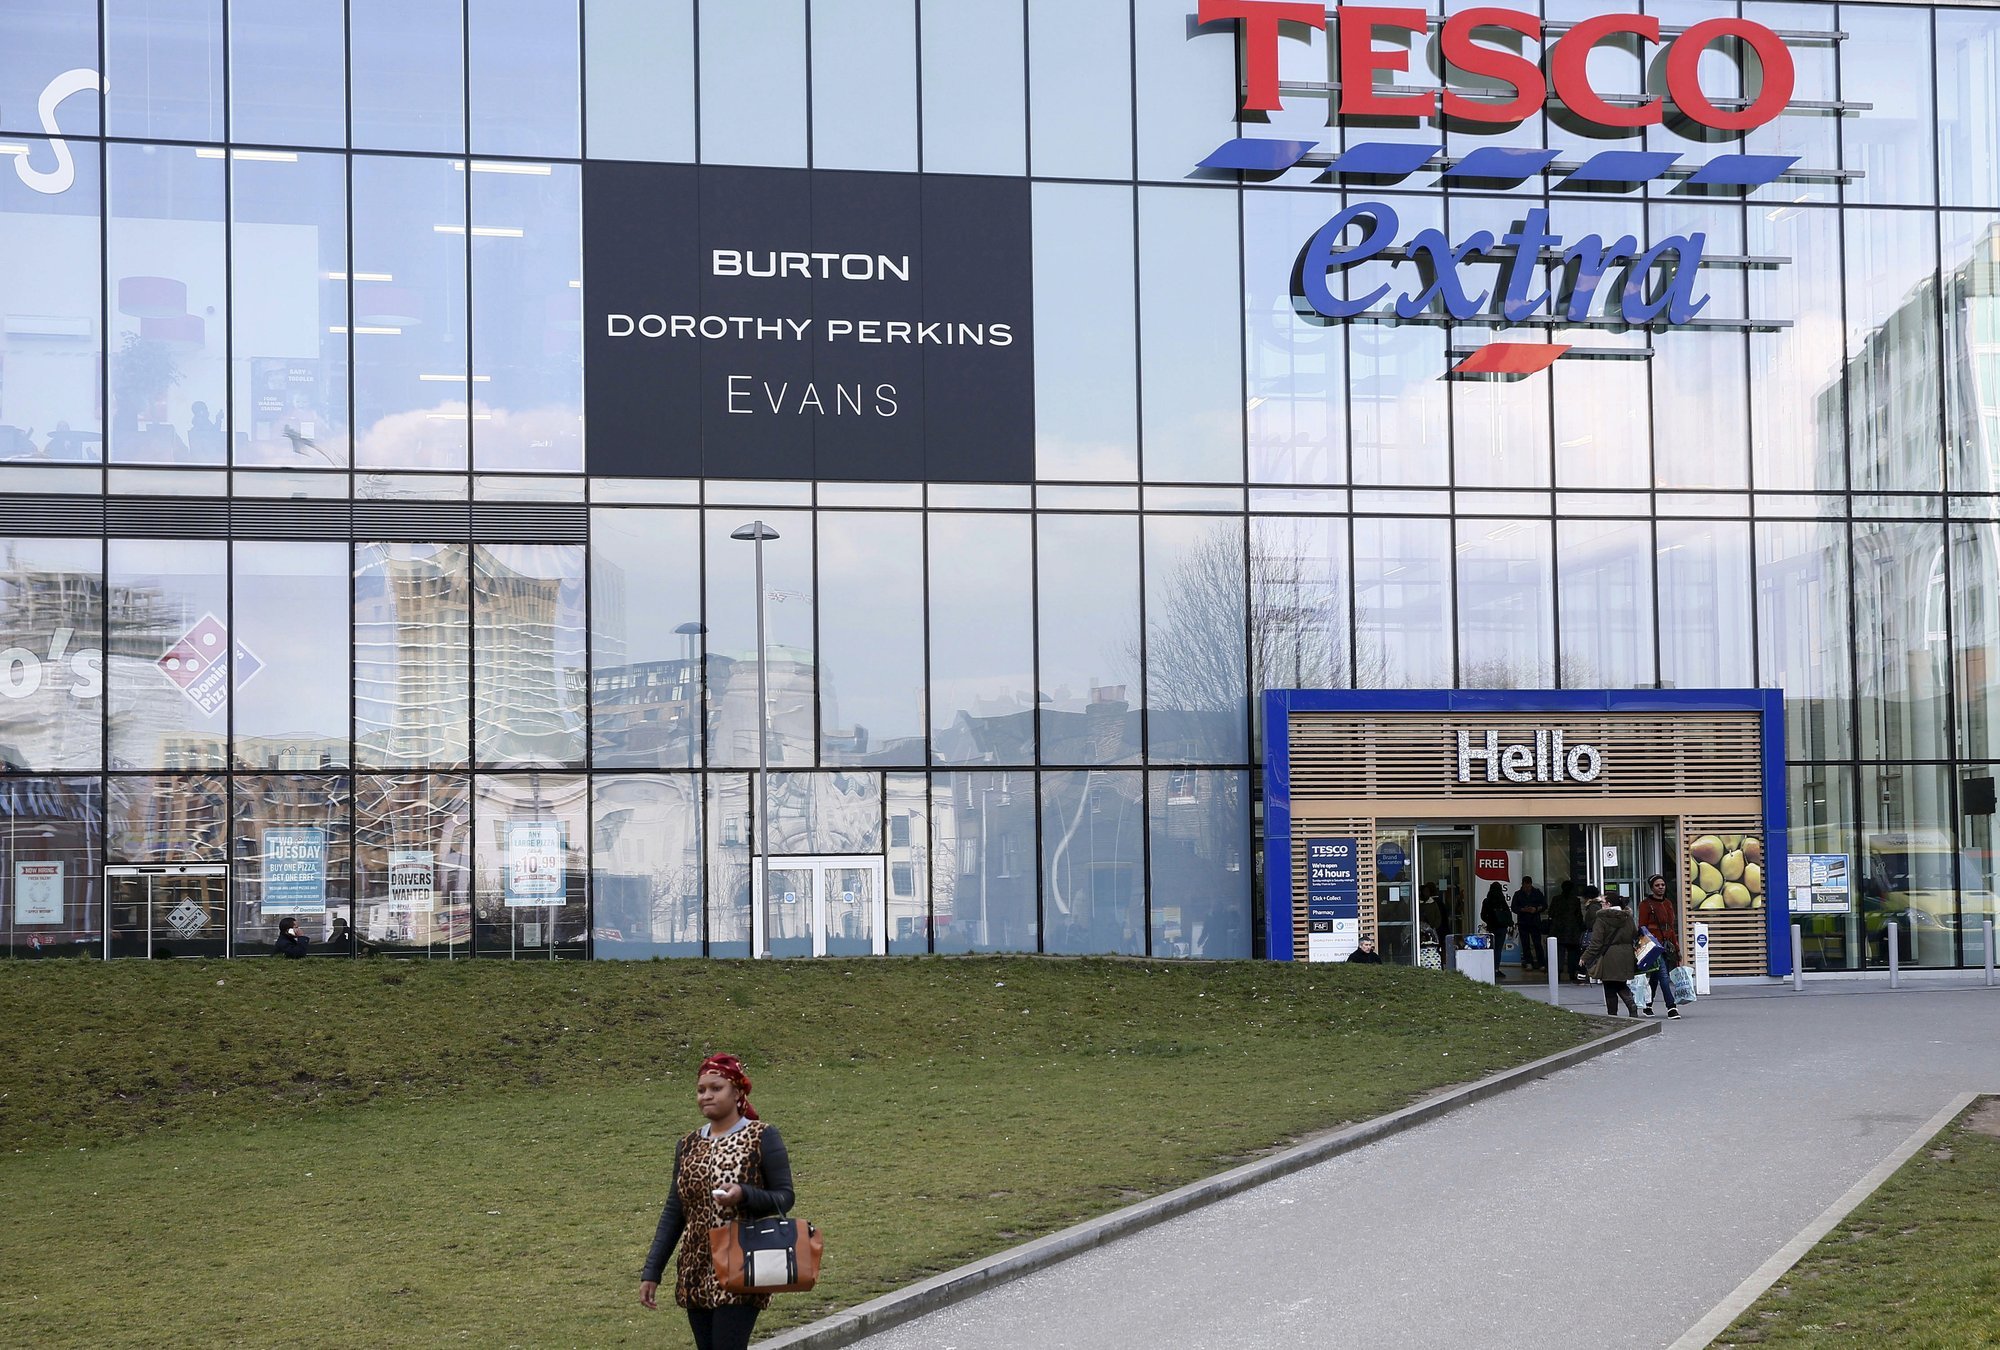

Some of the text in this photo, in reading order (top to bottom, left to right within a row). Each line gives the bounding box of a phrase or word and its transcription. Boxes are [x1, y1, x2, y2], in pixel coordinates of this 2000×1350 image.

[1198, 0, 1795, 130] TESCO
[712, 249, 909, 281] BURTON
[1301, 202, 1710, 325] extra
[607, 314, 1013, 346] DOROTHY PERKINS
[728, 375, 898, 417] EVANS
[1456, 729, 1602, 782] Hello
[266, 837, 321, 859] TUESDAY
[1312, 846, 1348, 854] TESCO
[270, 863, 282, 872] BUY
[283, 863, 296, 872] ONE
[514, 856, 556, 873] £10.99
[1479, 859, 1505, 868] FREE
[272, 873, 315, 881] GET ONE FREE
[391, 873, 432, 885] DRIVERS
[1312, 869, 1351, 878] 24 hours
[392, 888, 430, 900] WANTED
